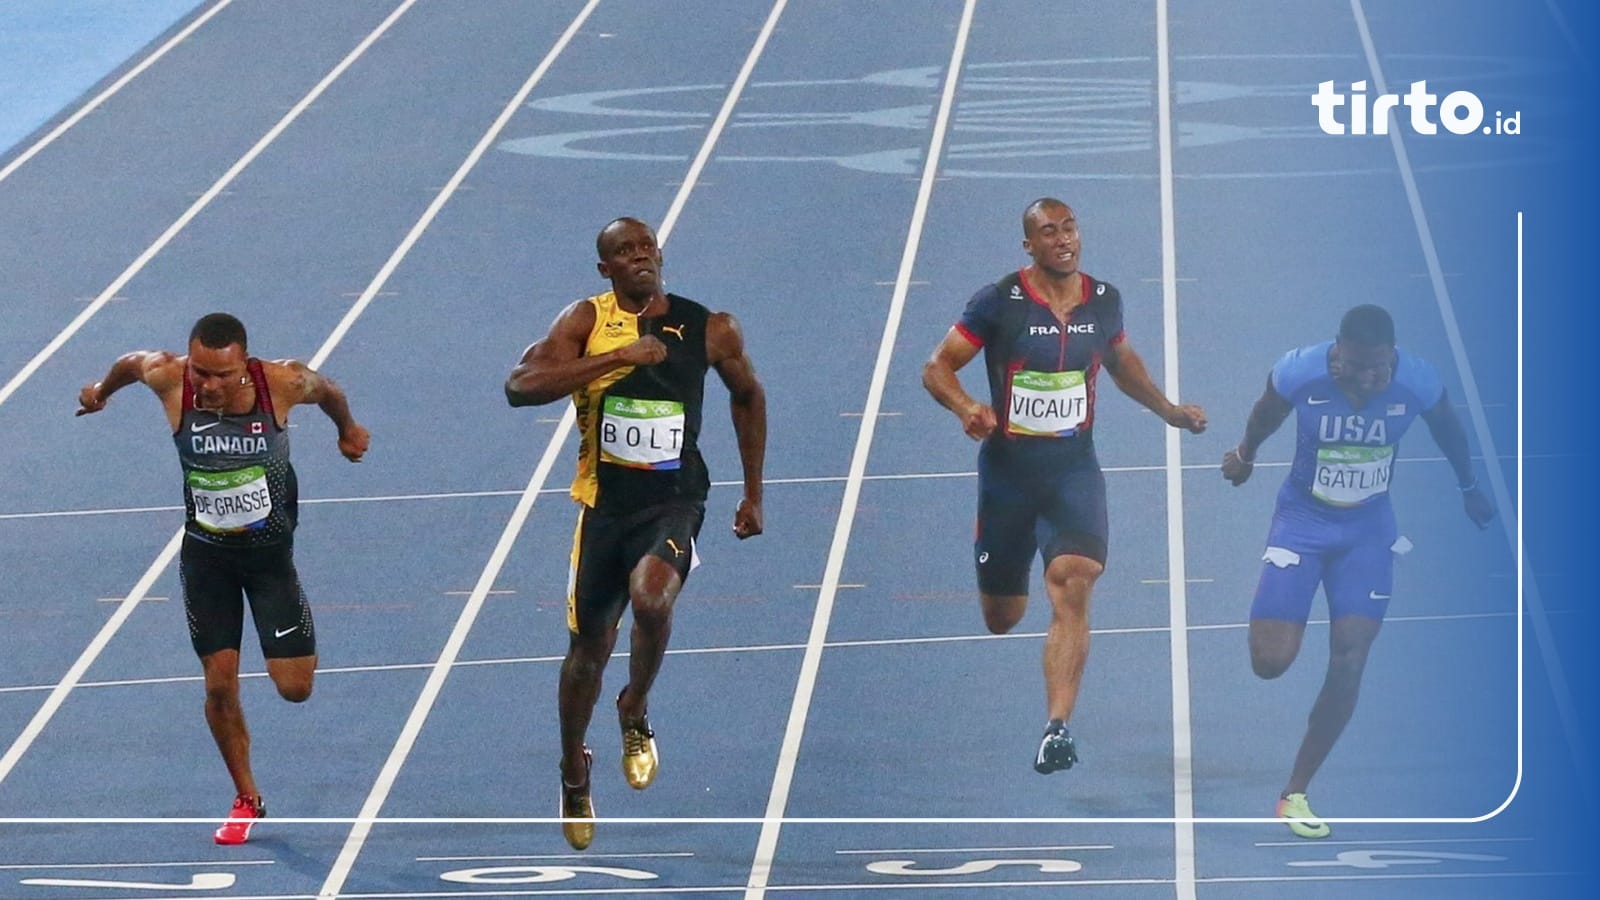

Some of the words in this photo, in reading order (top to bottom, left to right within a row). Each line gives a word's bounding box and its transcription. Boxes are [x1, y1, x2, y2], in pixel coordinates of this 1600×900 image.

[1030, 323, 1094, 336] FRANCE
[1013, 393, 1085, 418] VICAUT
[604, 423, 682, 450] BOLT
[1319, 415, 1387, 445] USA
[191, 435, 268, 454] CANADA
[1317, 466, 1389, 489] GATLIN
[195, 495, 213, 515] DE
[214, 488, 269, 516] GRASSE
